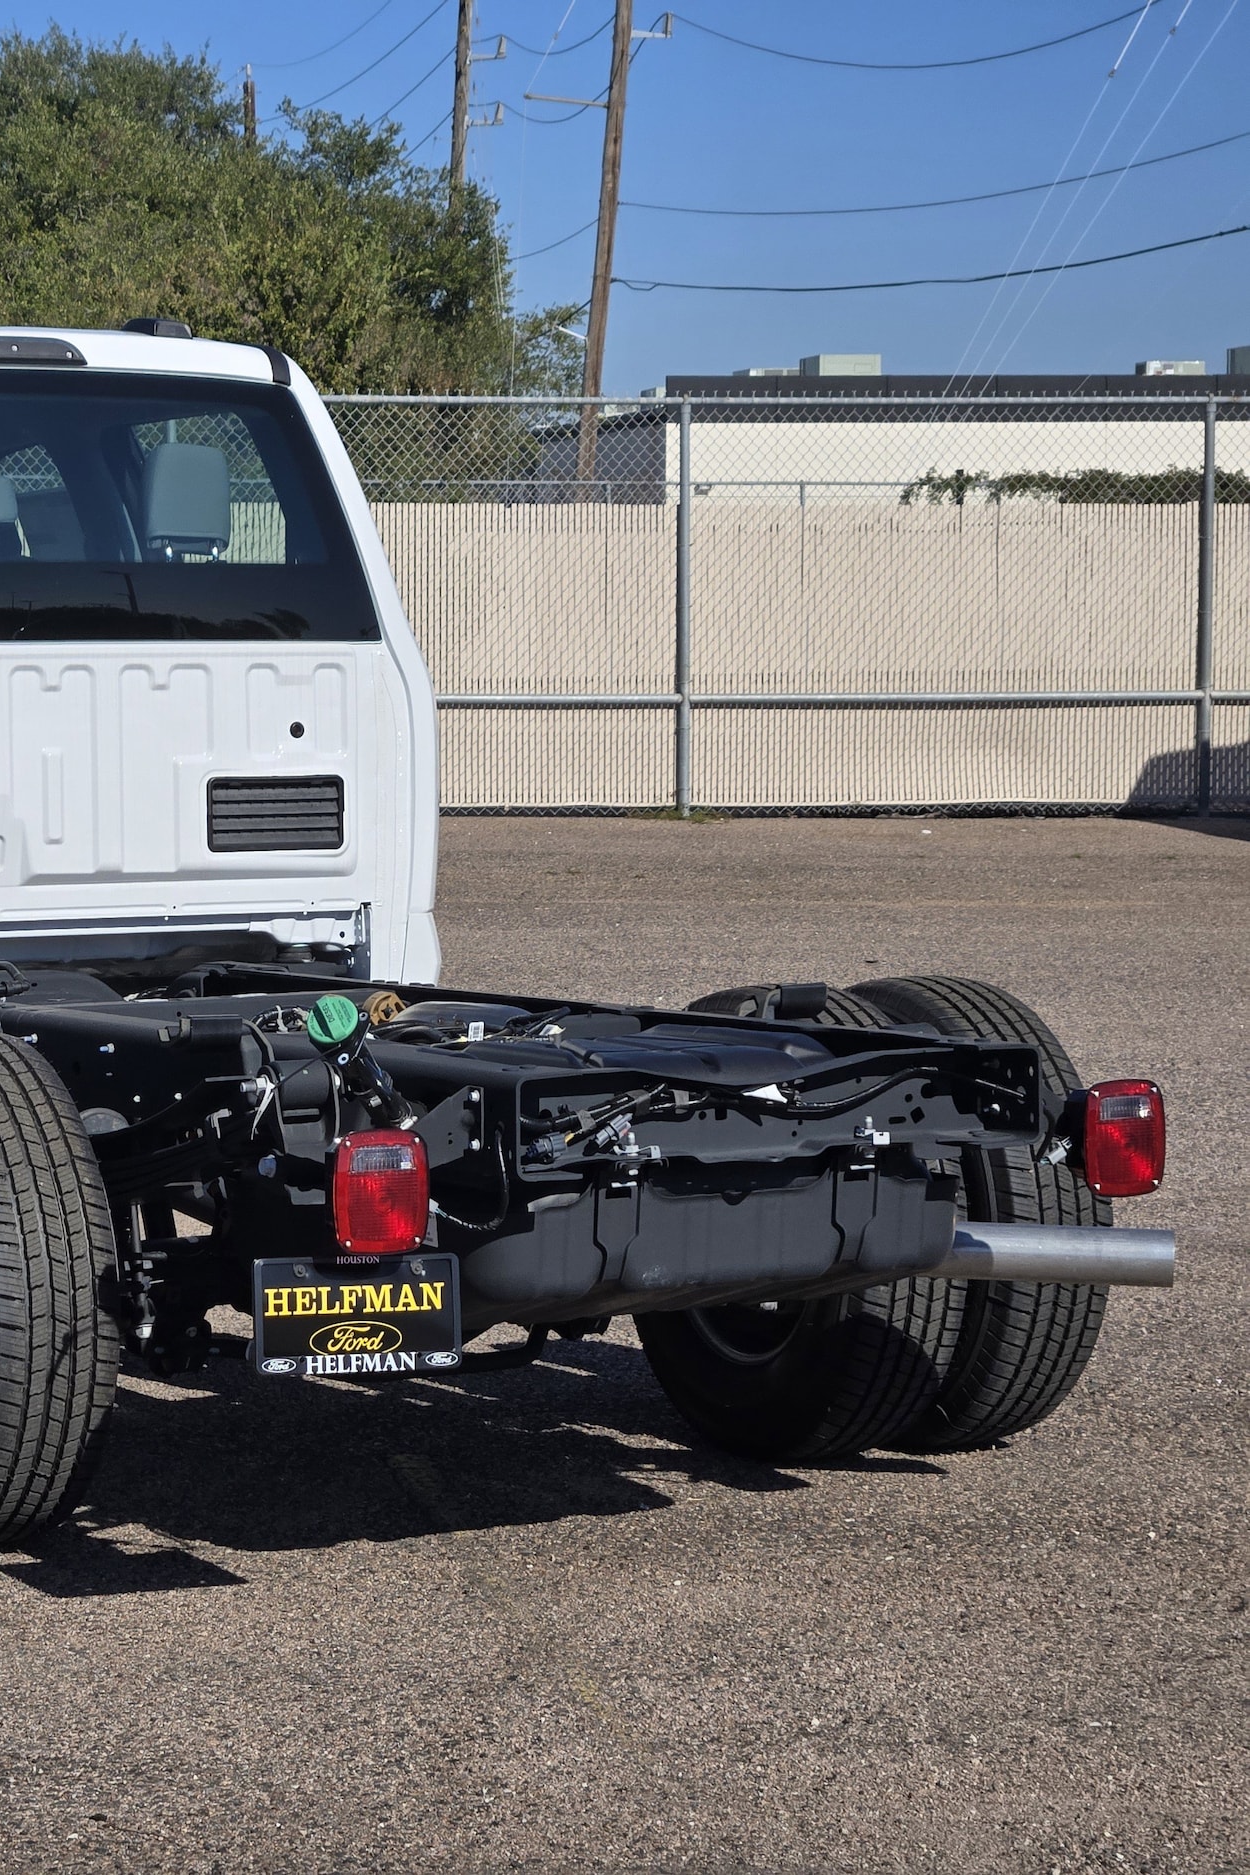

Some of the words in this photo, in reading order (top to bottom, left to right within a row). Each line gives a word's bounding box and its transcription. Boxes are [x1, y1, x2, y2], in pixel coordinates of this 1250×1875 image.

[336, 1256, 380, 1265] HOUSTON
[264, 1282, 445, 1317] HELFMAN
[327, 1325, 385, 1352] Ford
[305, 1352, 418, 1375] HELFMAN
